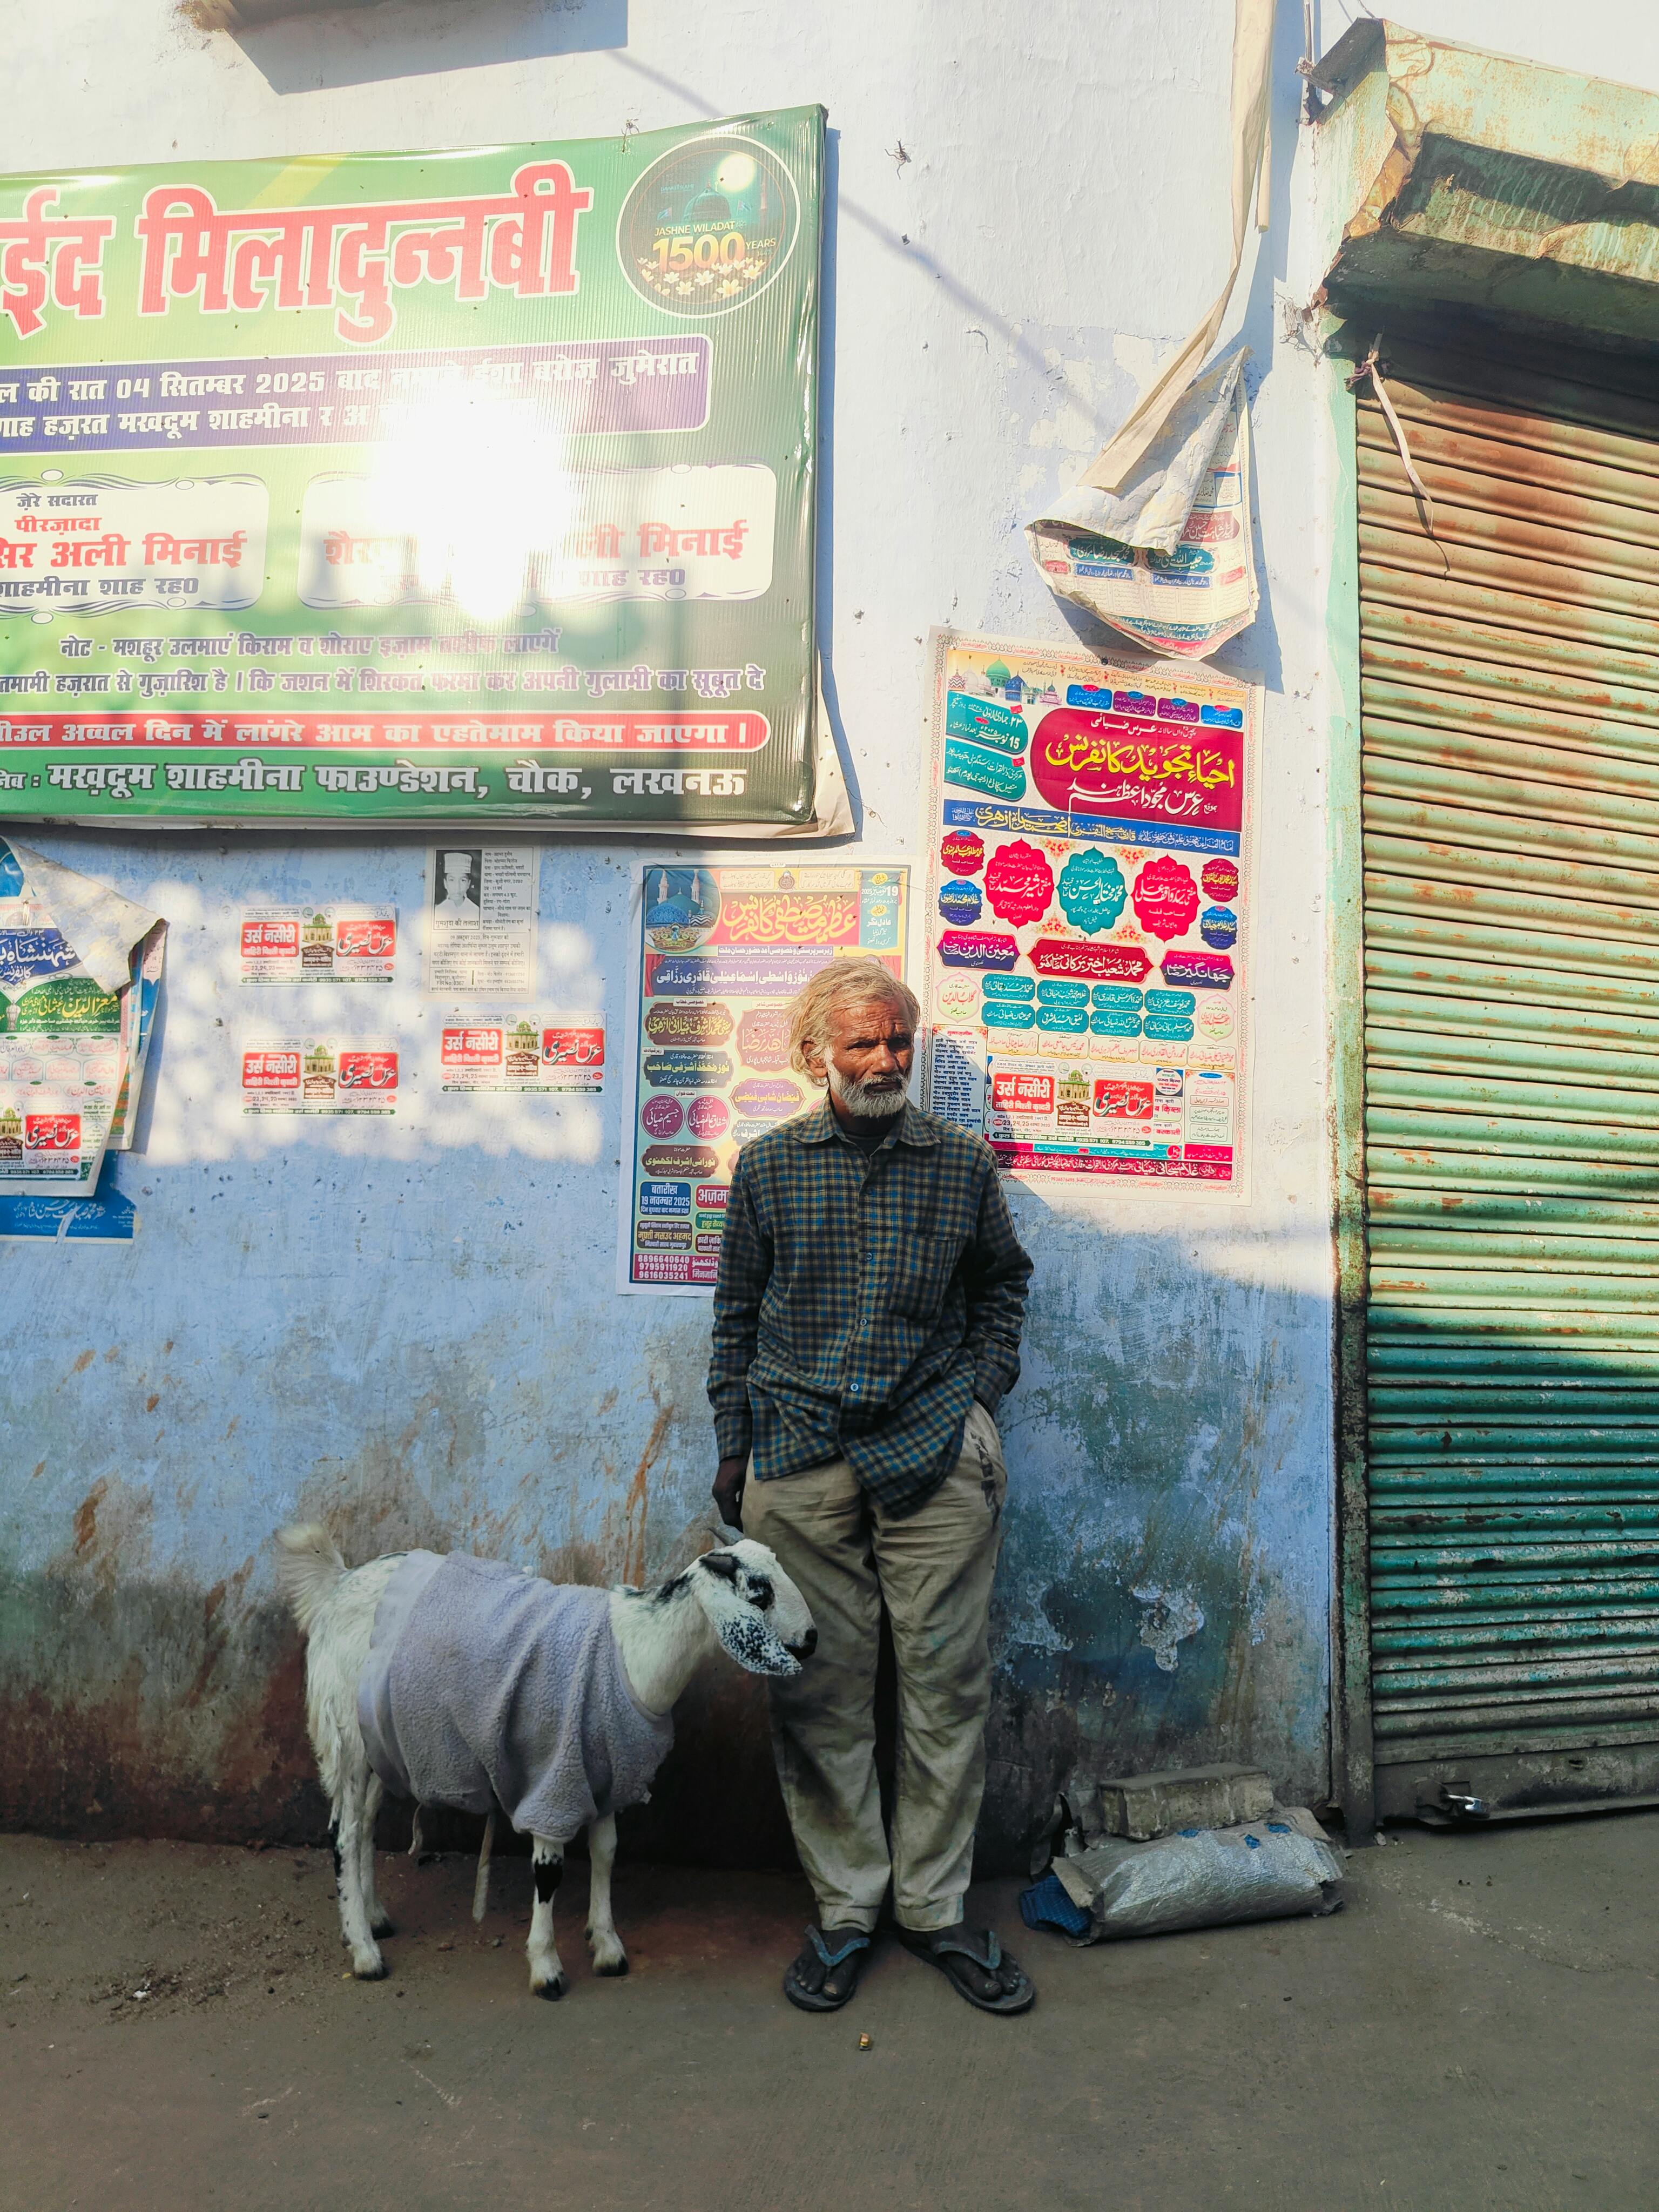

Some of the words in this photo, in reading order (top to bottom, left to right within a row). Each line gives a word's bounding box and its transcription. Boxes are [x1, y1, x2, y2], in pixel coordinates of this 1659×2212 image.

[655, 224, 691, 236] JASHNE
[693, 221, 736, 232] WILADAT
[0, 186, 115, 339] ईद
[135, 159, 594, 346] मिलादुन्नबी
[652, 232, 745, 273] 1500
[746, 238, 776, 250] YEARS
[27, 376, 61, 402] की
[68, 380, 107, 400] रात
[116, 378, 150, 399] 04
[159, 370, 246, 397] सितम्बर
[256, 372, 325, 394] 2025
[609, 349, 700, 385] जुमेरात
[43, 414, 110, 441] हज़रत
[117, 411, 200, 439] मखदूम
[208, 402, 311, 430] शाहमीना
[47, 493, 98, 507] सदारत
[15, 515, 102, 535] पीरज़ादा
[51, 534, 131, 567] अली
[143, 530, 247, 568] मिनाई
[636, 519, 749, 561] मिनाई
[98, 578, 146, 595] शाह
[60, 635, 93, 658] नोट
[113, 636, 163, 663] मशहूर
[169, 632, 235, 657] उलमाएं
[238, 632, 293, 657] किराम
[55, 673, 111, 698] हज़रात
[116, 670, 132, 692] से
[139, 669, 207, 698] गुज़ारिश
[213, 669, 229, 692] है
[249, 669, 272, 692] कि
[280, 672, 330, 692] जशन
[337, 669, 356, 692] में
[359, 668, 424, 692] शिरकत
[485, 672, 517, 692] कर
[522, 666, 581, 691] अपनी
[584, 665, 650, 697] गुलामी
[657, 669, 688, 691] का
[692, 669, 743, 697] सूबूत
[745, 665, 766, 691] दे
[144, 720, 193, 741] दिन
[202, 719, 230, 741] में
[315, 725, 372, 742] आम
[382, 724, 421, 742] का
[431, 719, 544, 743] एहतेमाम
[552, 719, 626, 743] किया
[636, 724, 729, 743] जाएगा
[1009, 734, 1021, 750] 15
[164, 758, 307, 792] शाहमीना
[505, 760, 592, 800] चौक,
[611, 768, 747, 797] लखनऊ
[887, 886, 899, 896] 19
[245, 924, 262, 944] उर्स
[265, 923, 296, 944] नसीरी
[435, 920, 453, 928] गुमशुदा
[455, 918, 462, 926] की
[445, 1030, 463, 1051] उर्स
[466, 1030, 498, 1050] नसीरी
[246, 1054, 264, 1075] उर्स
[266, 1054, 297, 1075] नसीरी
[996, 1076, 1016, 1096] उर्स
[1017, 1077, 1050, 1099] नसीरी
[651, 1183, 678, 1195] बतारीख
[642, 1196, 648, 1205] 19
[649, 1196, 673, 1206] नवम्बर
[674, 1197, 690, 1206] 2025
[673, 1232, 692, 1241] अहमद
[638, 1255, 690, 1264] 8896640640
[639, 1263, 688, 1271] 9795911920
[639, 1271, 688, 1280] 9616035241
